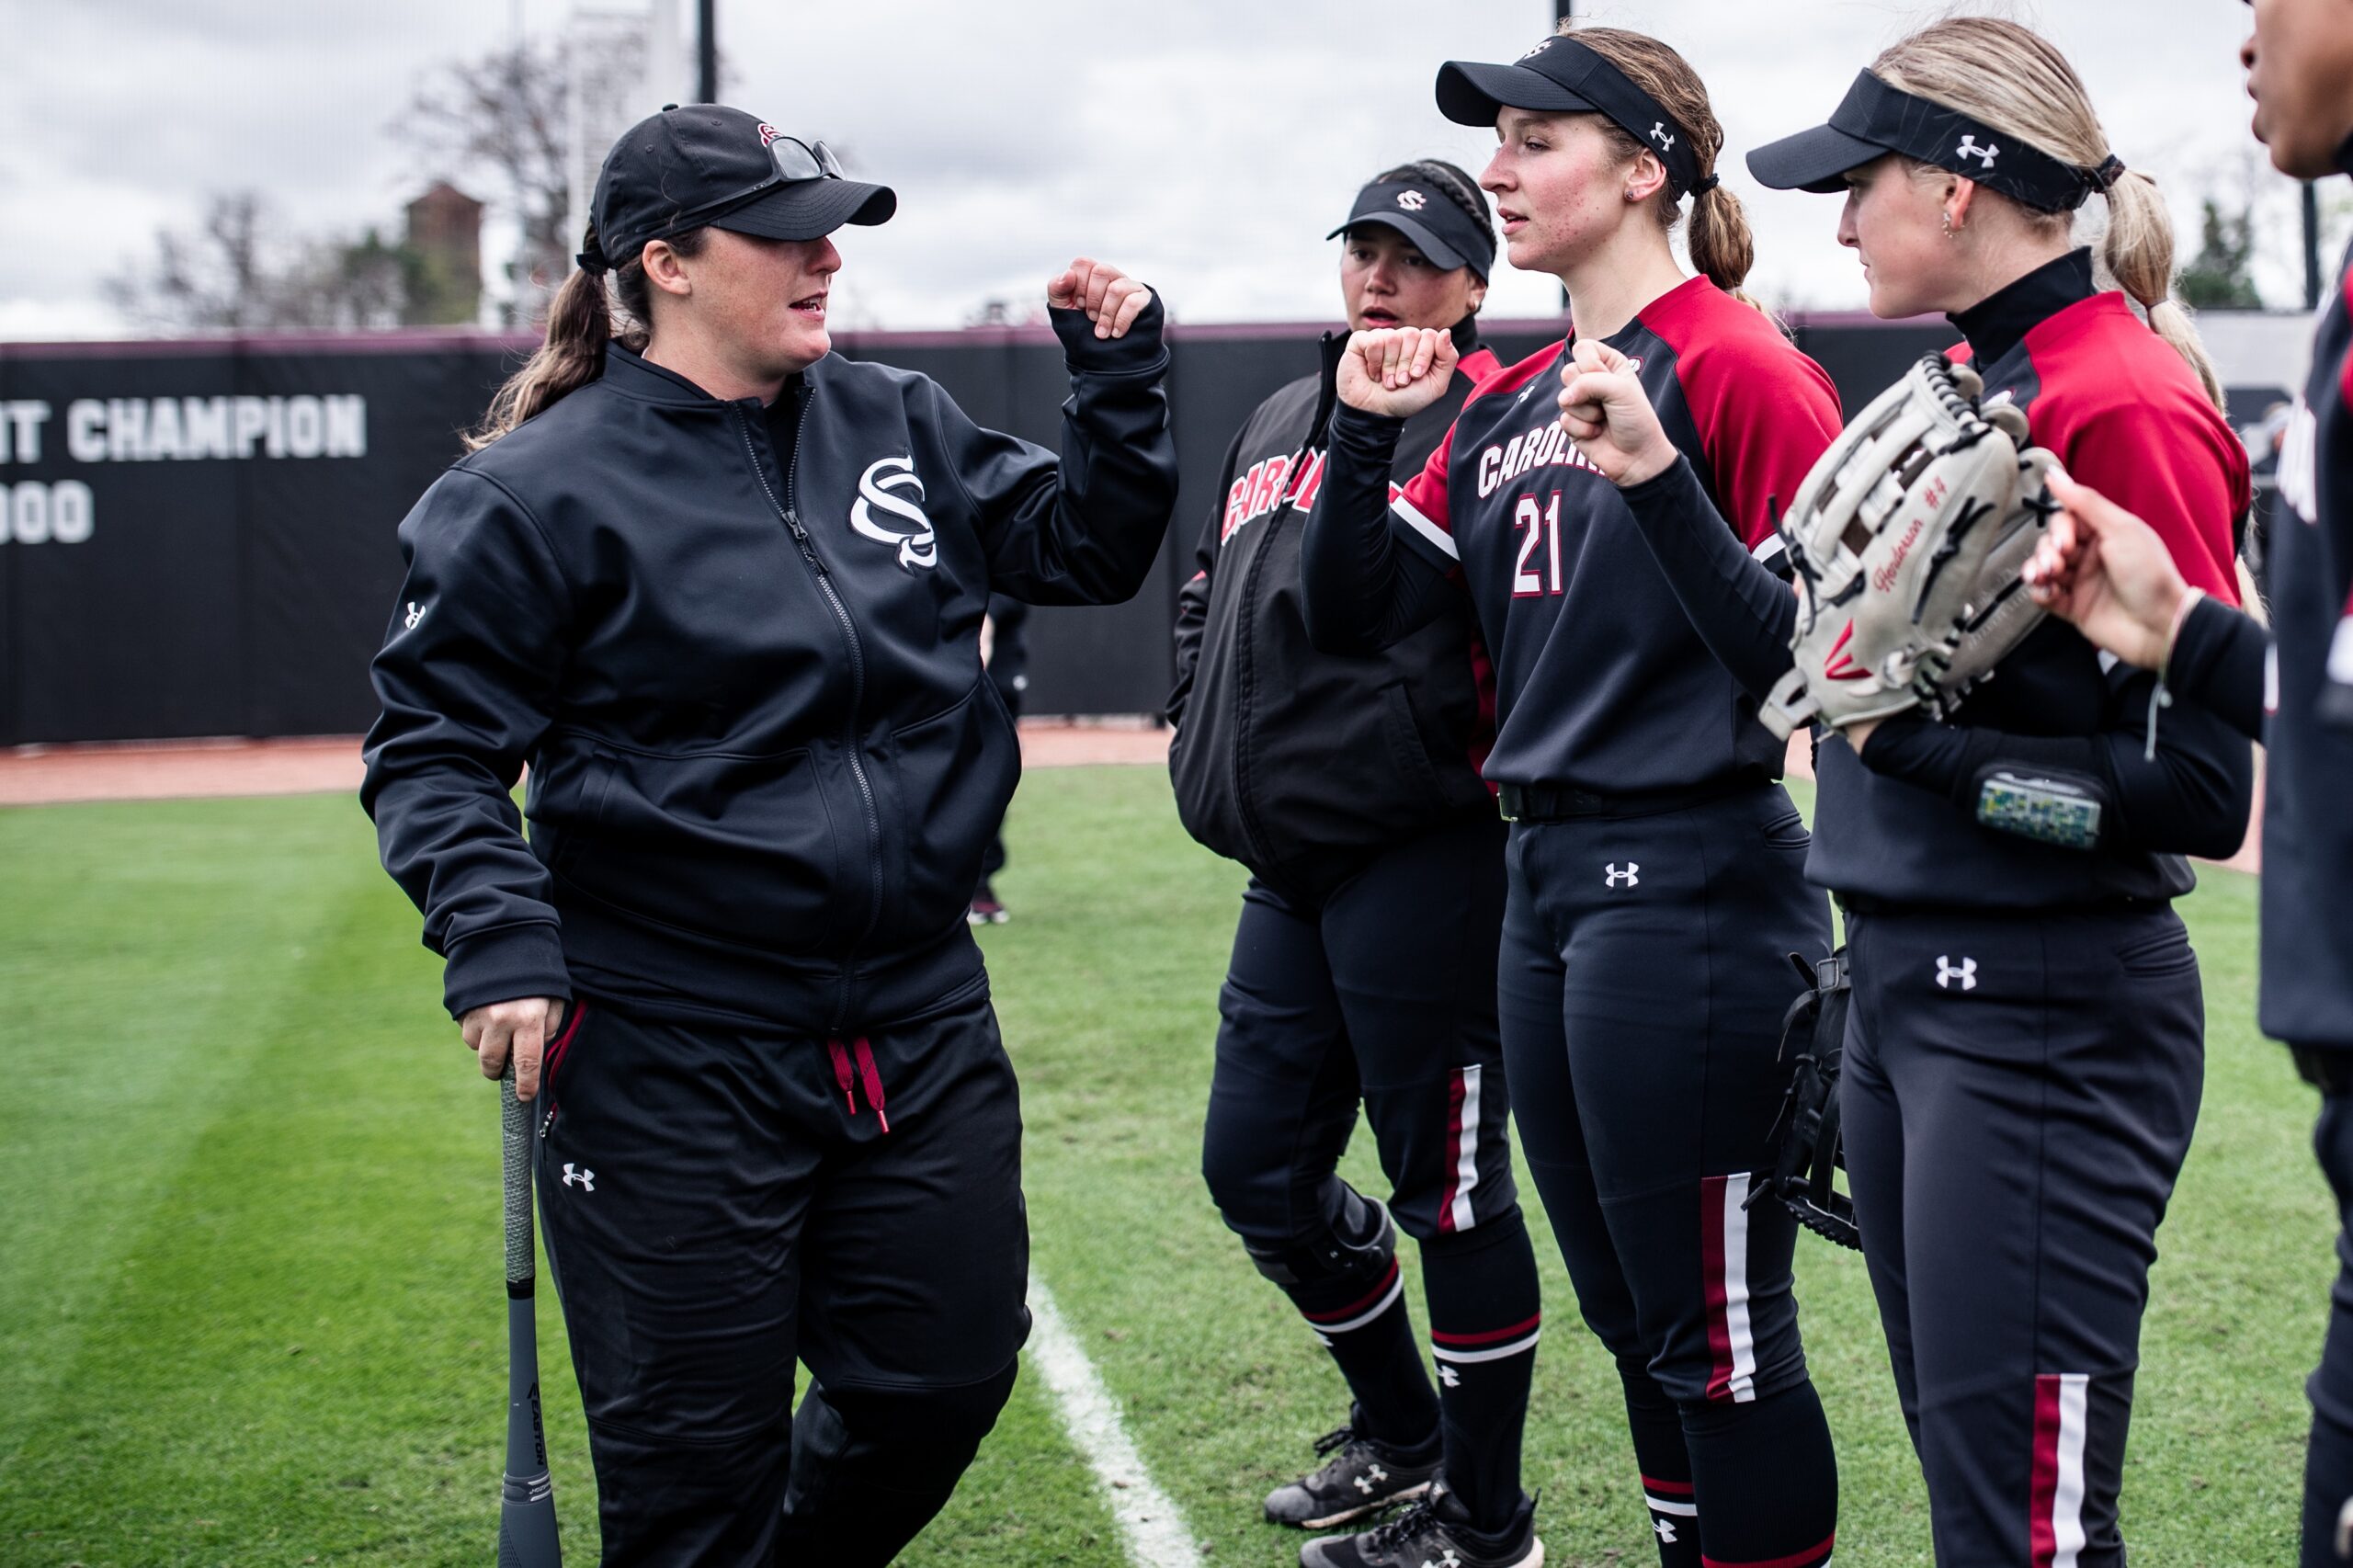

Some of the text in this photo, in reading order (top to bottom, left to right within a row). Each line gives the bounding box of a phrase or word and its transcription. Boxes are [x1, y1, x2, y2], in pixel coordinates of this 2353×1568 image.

[67, 393, 367, 461] CHAMPION
[1478, 420, 1607, 499] CAROL
[1221, 446, 1327, 547] CAROL
[1512, 489, 1563, 597] 21
[531, 1399, 545, 1466] EASTON
